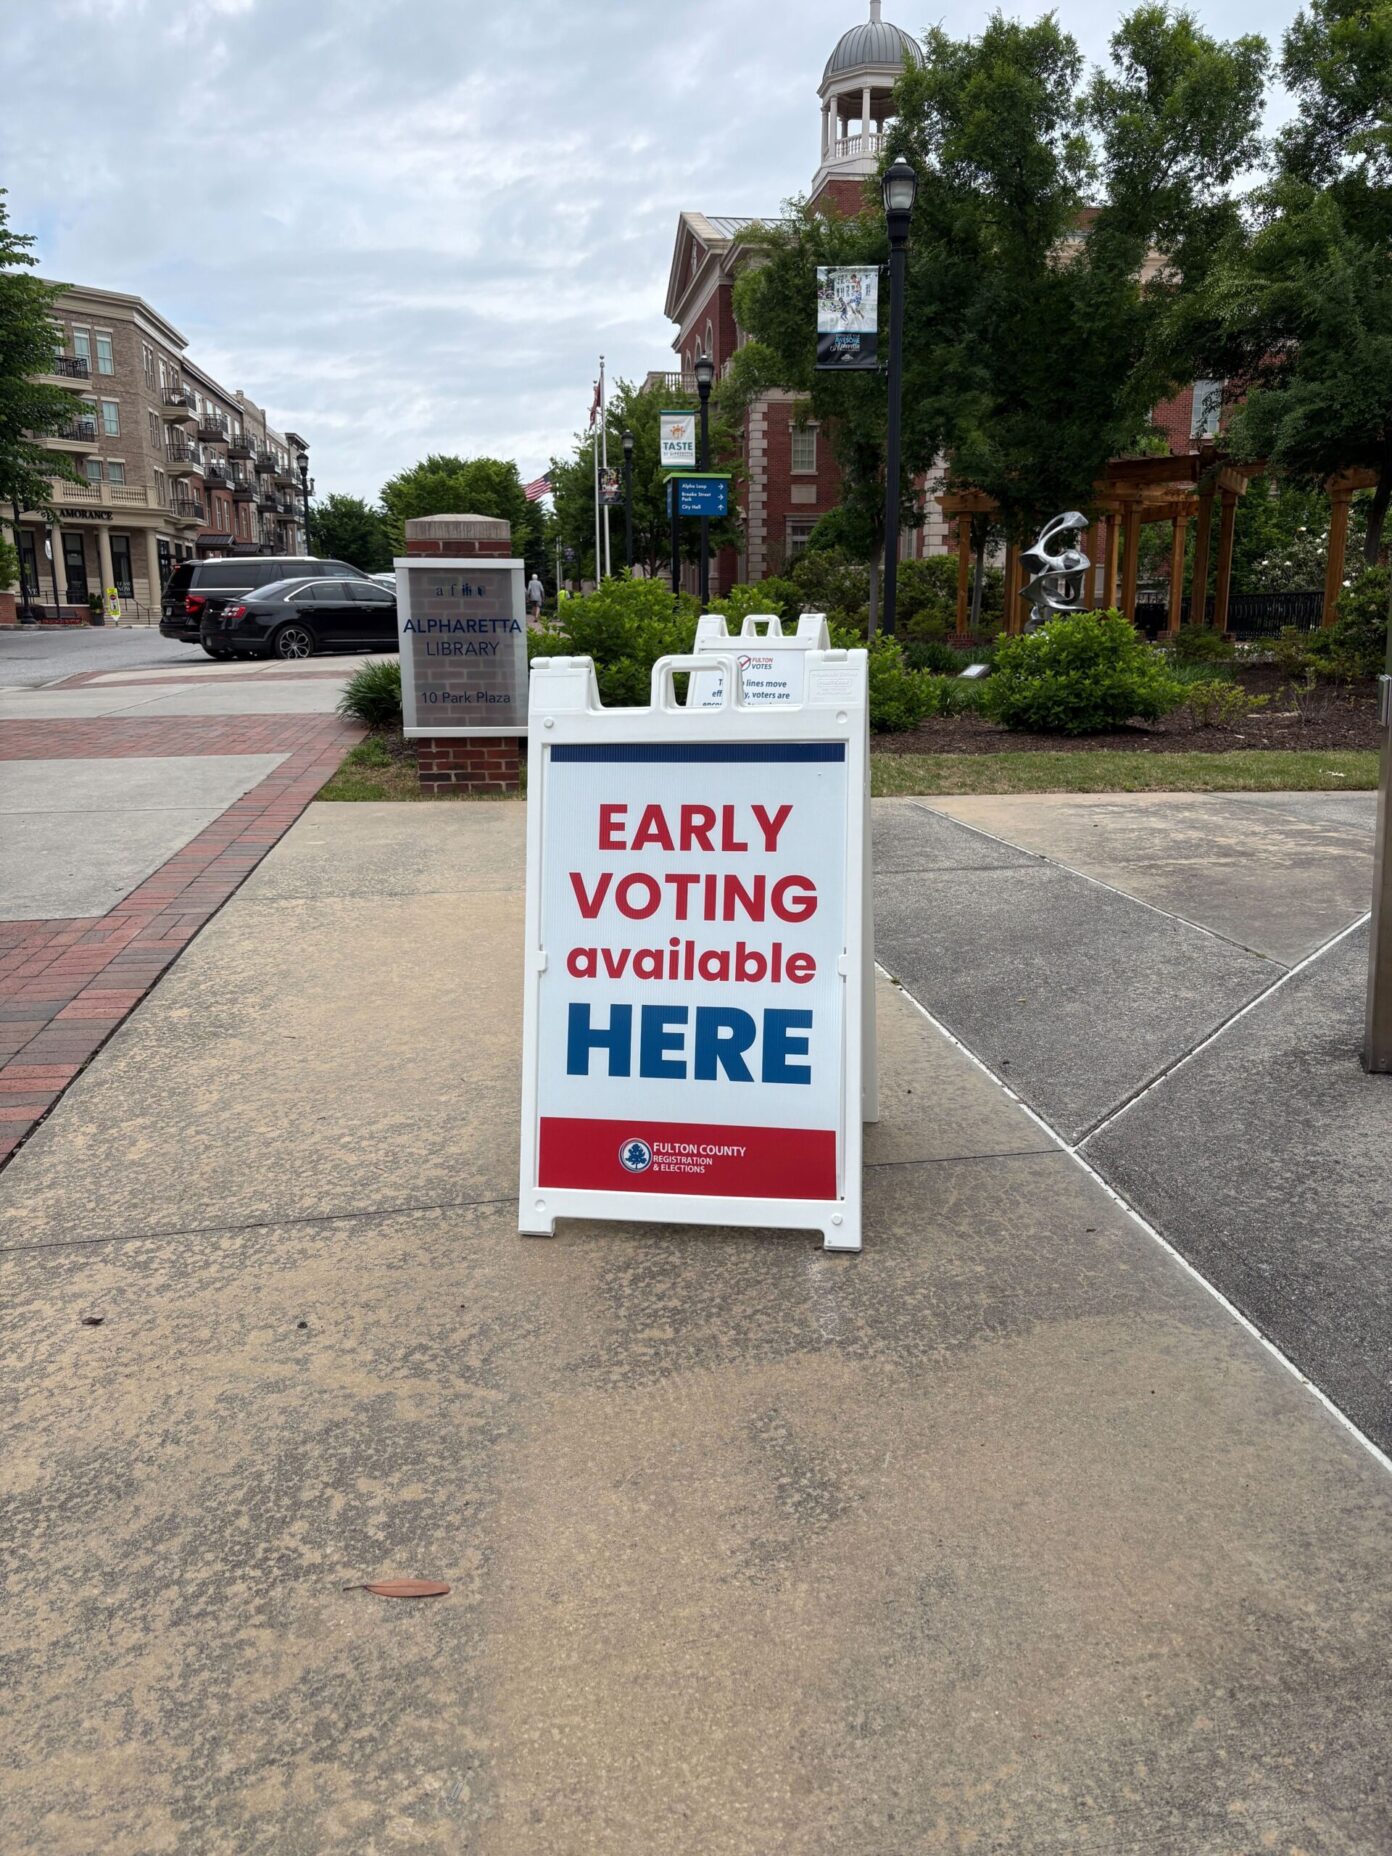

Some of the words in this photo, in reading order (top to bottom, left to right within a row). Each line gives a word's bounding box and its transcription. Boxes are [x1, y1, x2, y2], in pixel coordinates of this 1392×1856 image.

[663, 442, 693, 450] TASTE
[59, 508, 114, 521] AMORANCE
[403, 618, 522, 633] ALPHARETTA
[426, 641, 500, 656] LIBRARY
[765, 680, 787, 688] move
[422, 692, 438, 704] 10
[442, 691, 472, 704] Park
[476, 691, 511, 704] Plaza
[598, 803, 794, 852] EARLY
[569, 872, 818, 923] VOTING
[566, 936, 817, 984] available
[566, 1002, 813, 1085] HERE
[653, 1142, 697, 1154] FULTON
[699, 1145, 746, 1156] COUNTY
[653, 1155, 712, 1165] REGISTRATION
[660, 1164, 705, 1173] ELECTIONS
